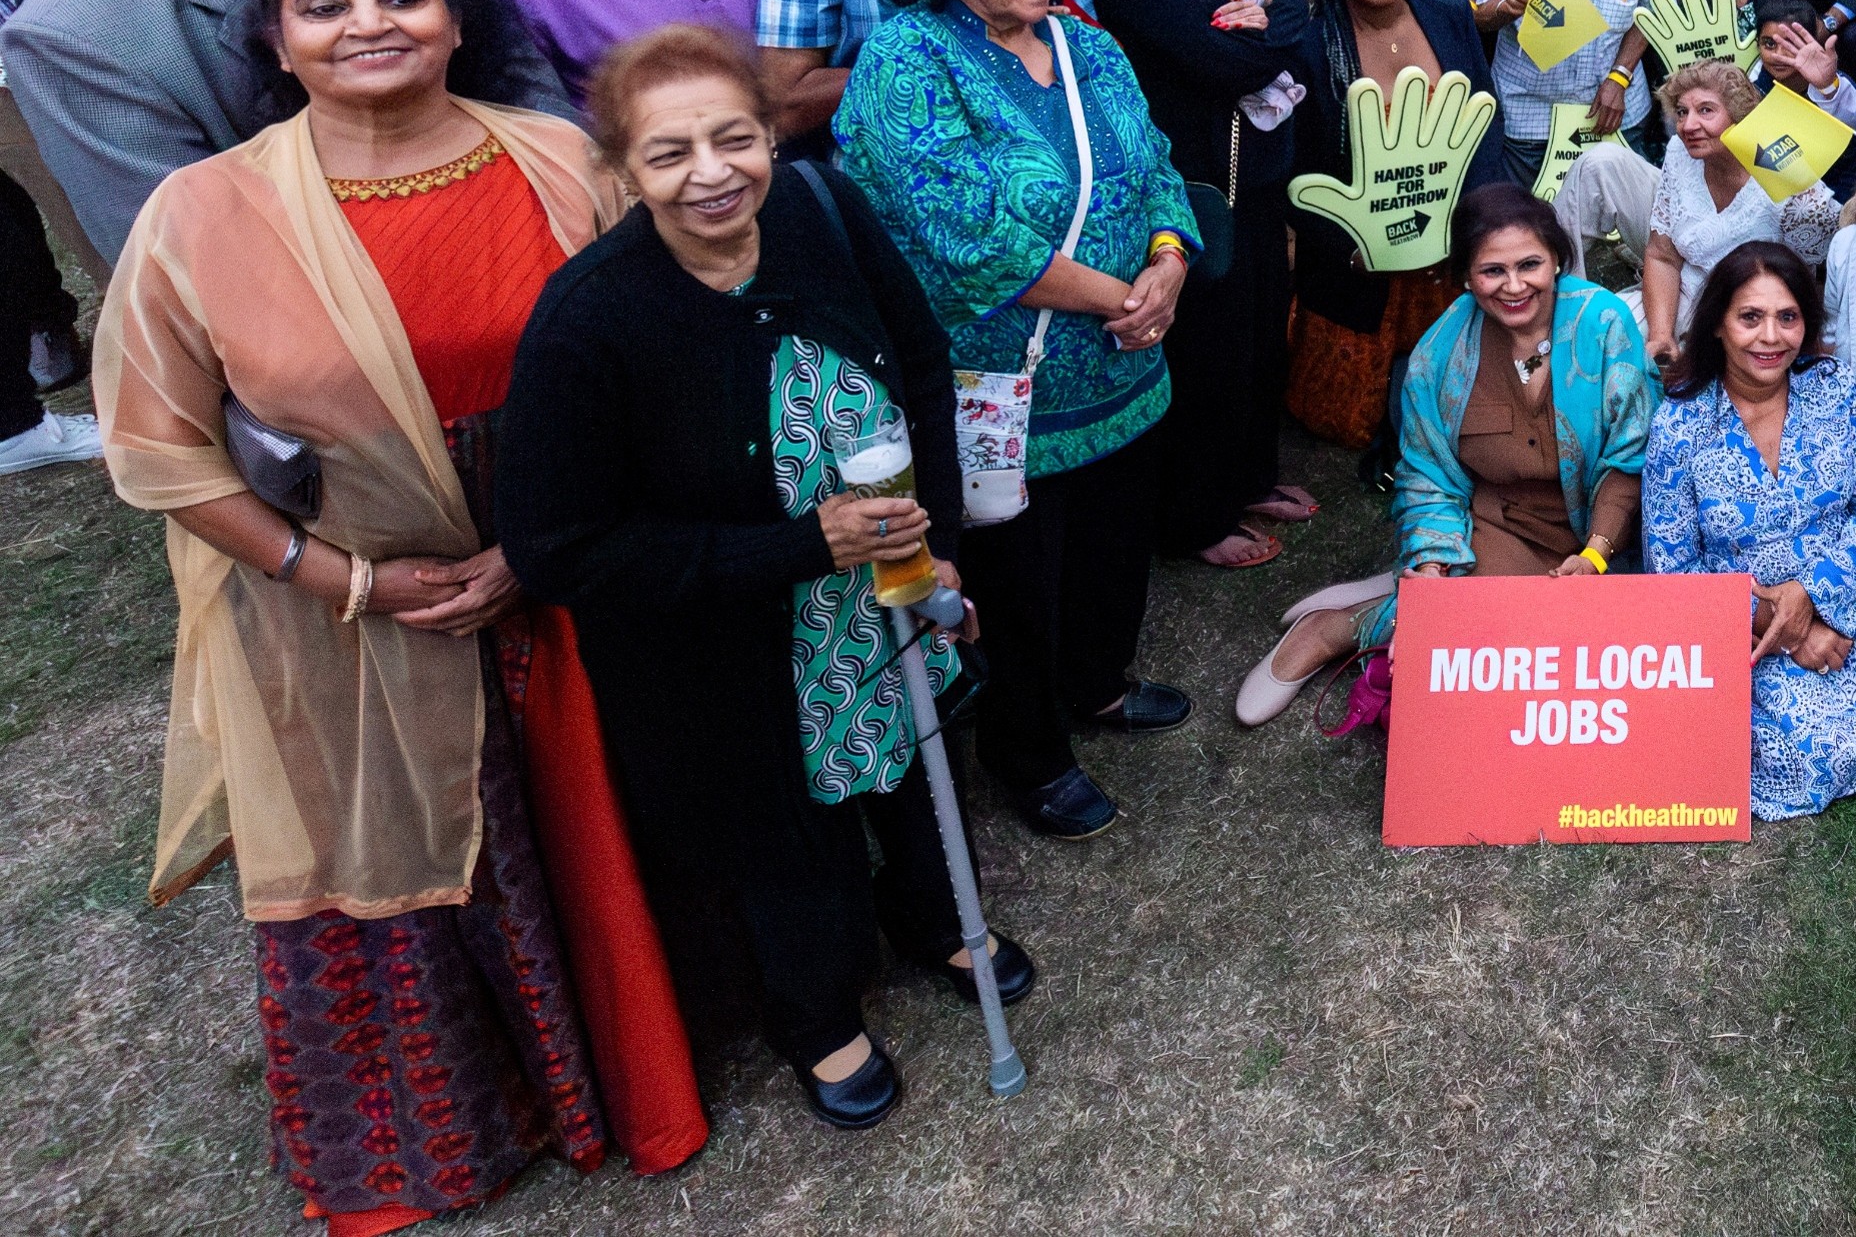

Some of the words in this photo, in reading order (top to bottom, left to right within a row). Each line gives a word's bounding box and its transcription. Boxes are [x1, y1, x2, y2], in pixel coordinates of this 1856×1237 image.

[1676, 38, 1713, 54] HANDS
[1714, 34, 1729, 46] UP
[1694, 48, 1716, 58] FOR
[1374, 164, 1424, 183] HANDS
[1429, 161, 1448, 175] UP
[1397, 178, 1425, 195] FOR
[1370, 187, 1449, 213] HEATHROW
[1387, 219, 1418, 238] BACK
[1429, 647, 1560, 692] MORE
[1575, 645, 1714, 690] LOCAL
[1510, 698, 1629, 746] JOBS
[1558, 803, 1739, 829] #backheathrow
